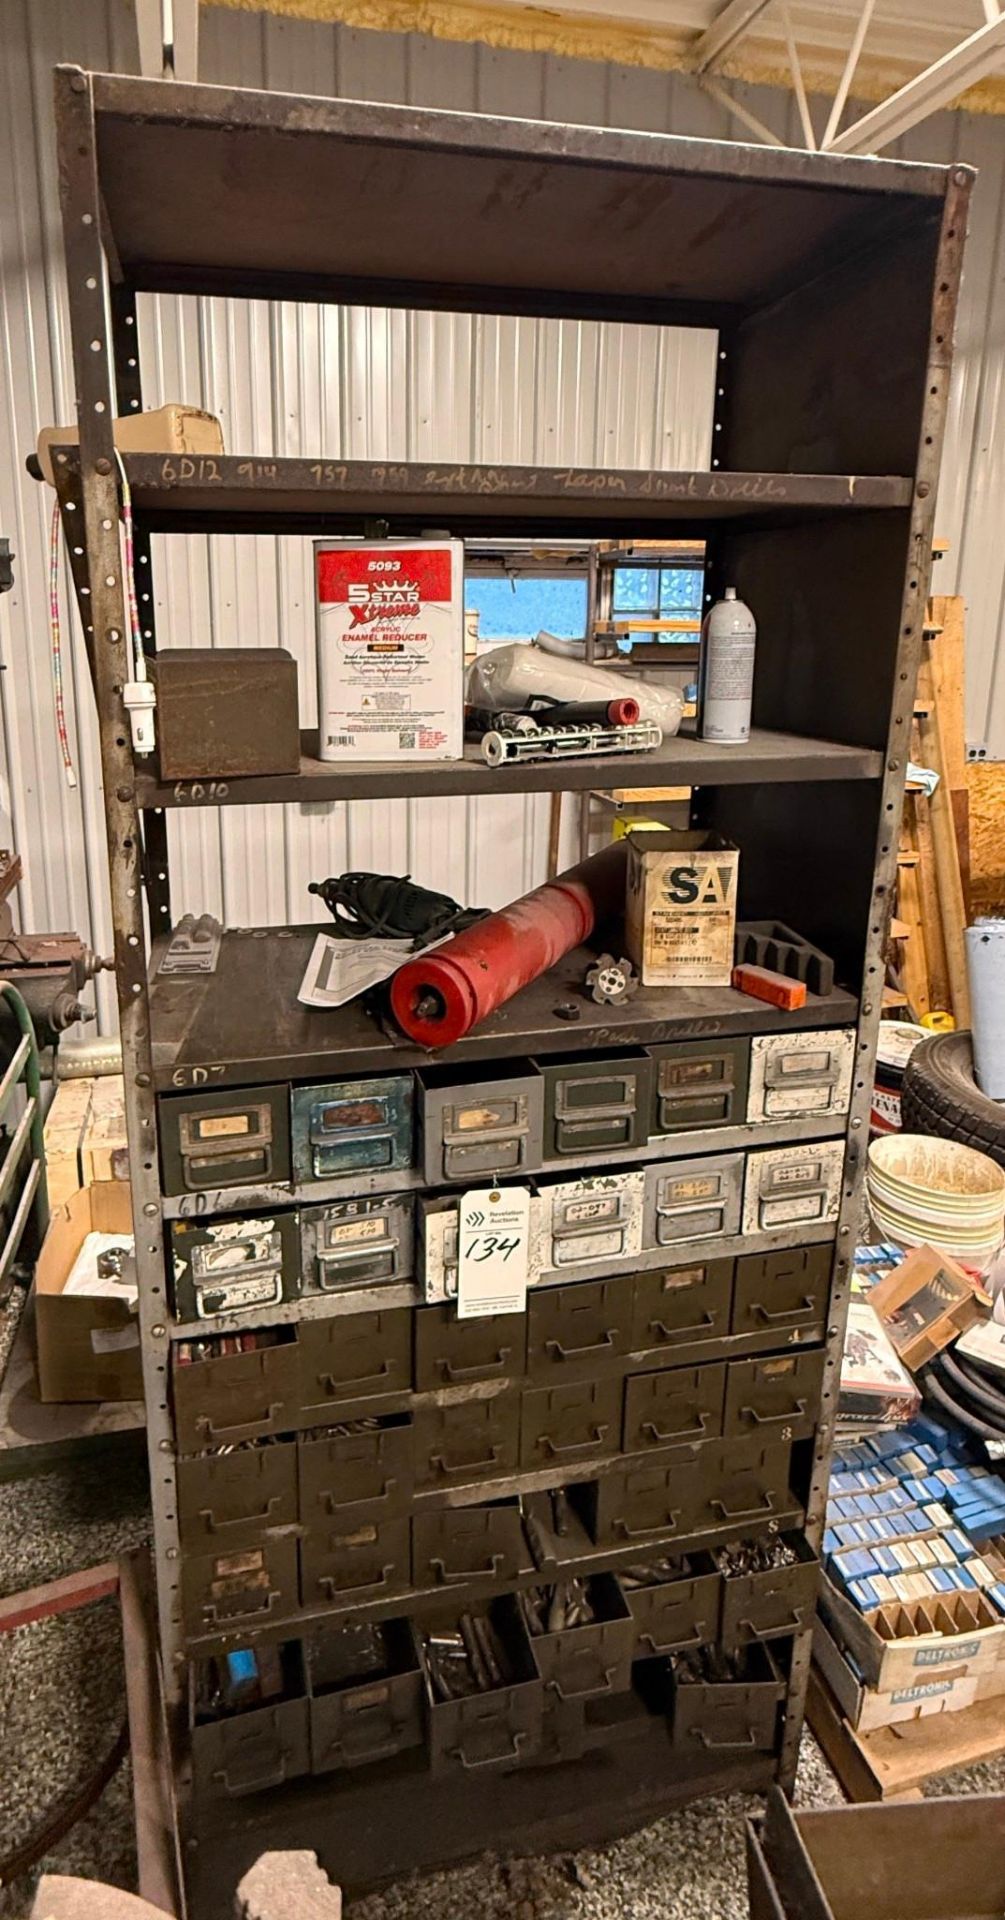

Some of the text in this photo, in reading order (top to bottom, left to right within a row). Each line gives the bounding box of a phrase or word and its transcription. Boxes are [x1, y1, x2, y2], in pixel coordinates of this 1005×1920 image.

[161, 457, 223, 481] 6D12
[368, 561, 401, 571] 5093
[348, 584, 419, 602] 5 STAR
[382, 633, 427, 641] REDUCER
[465, 1237, 521, 1262] 134
